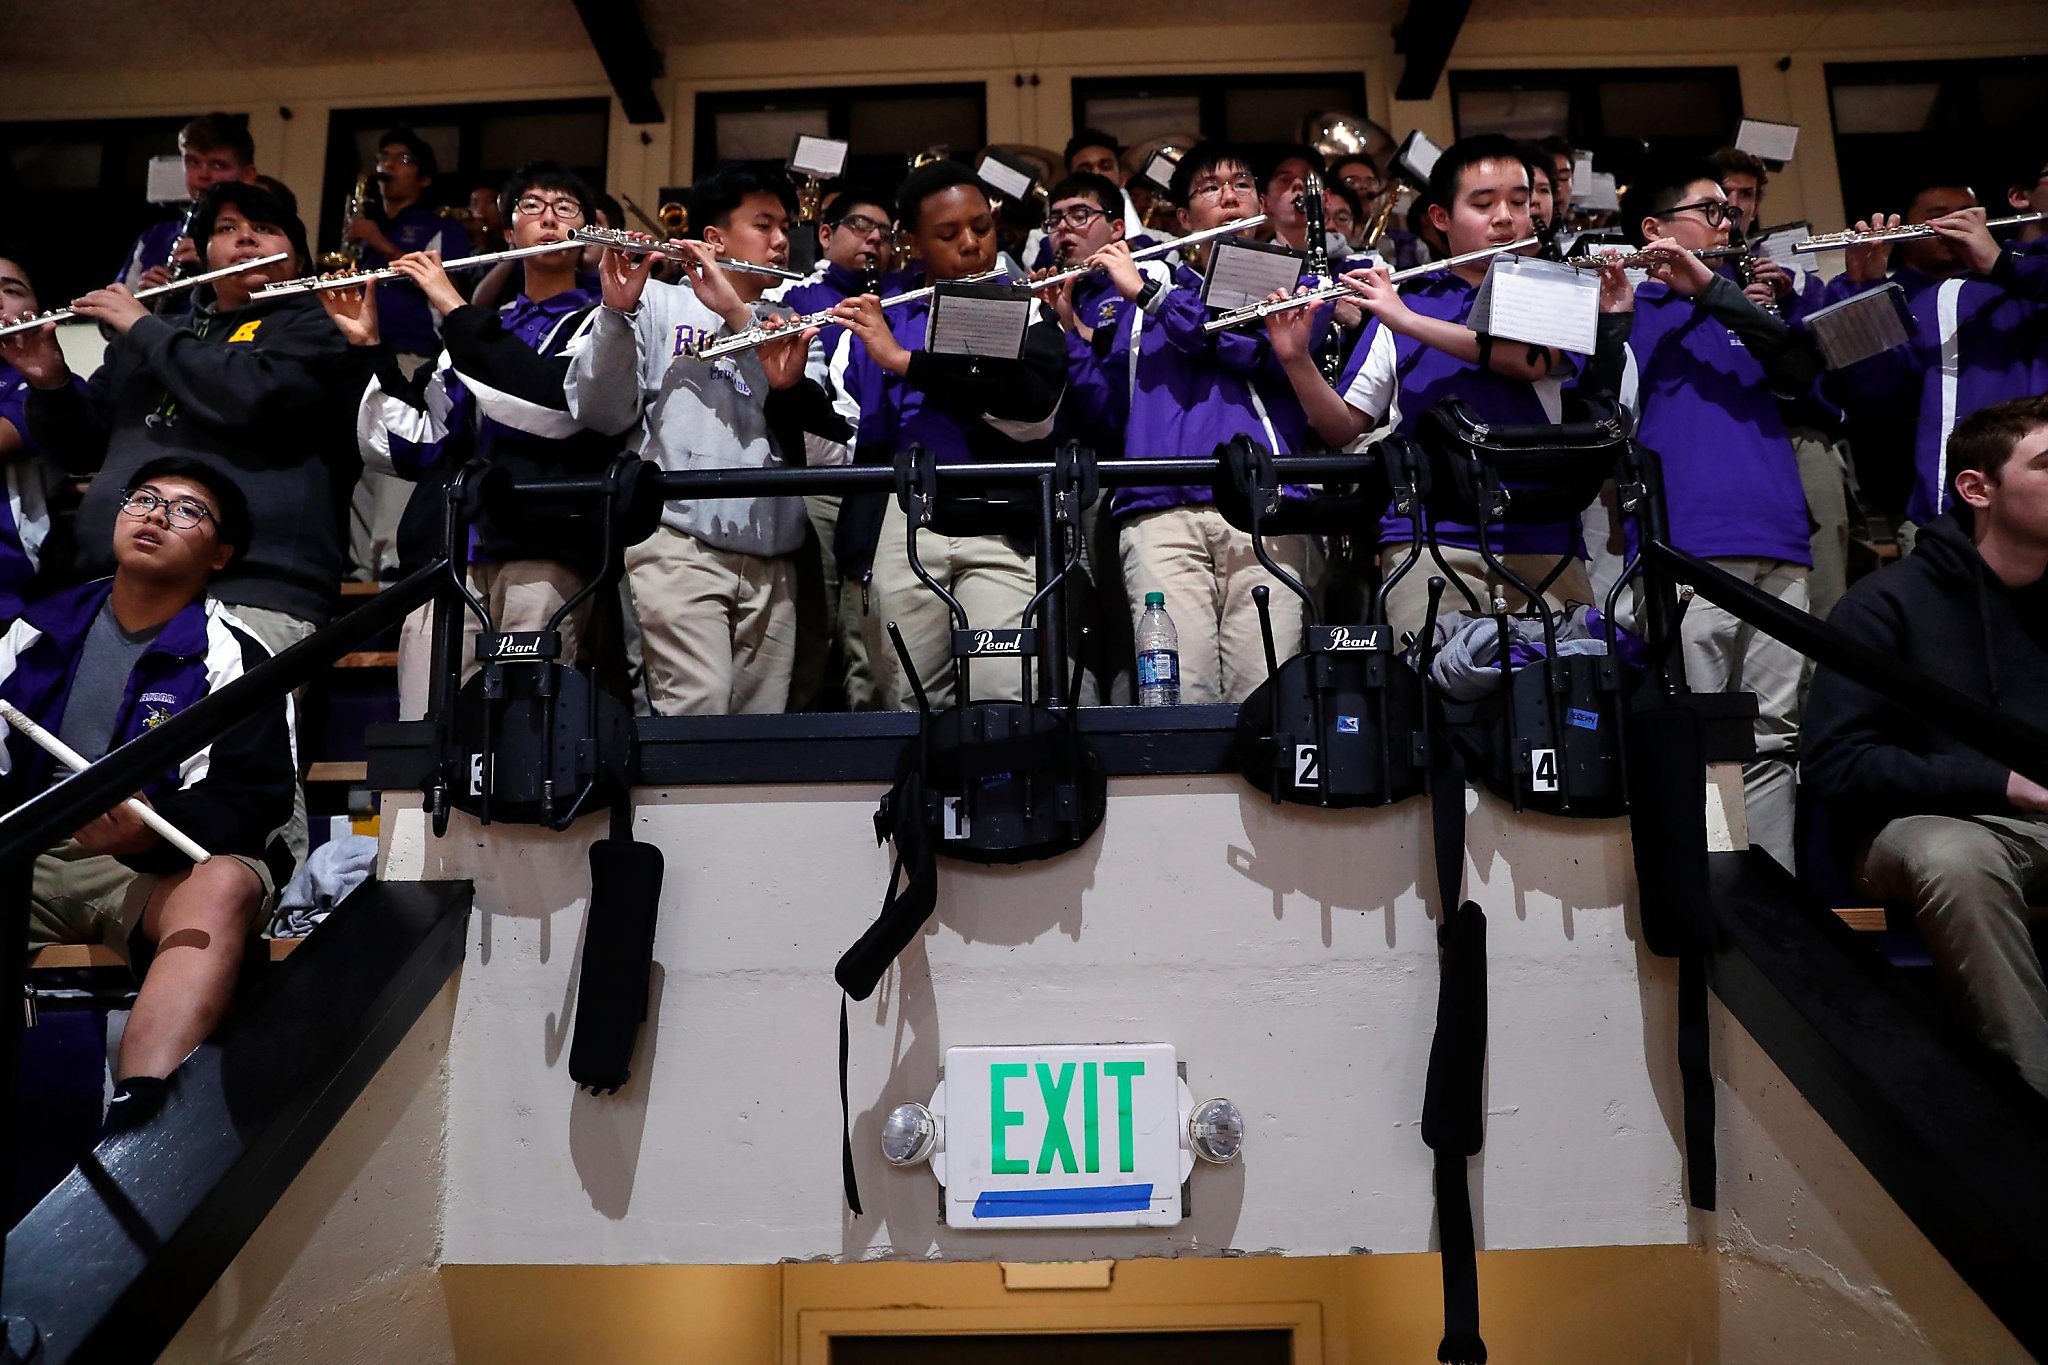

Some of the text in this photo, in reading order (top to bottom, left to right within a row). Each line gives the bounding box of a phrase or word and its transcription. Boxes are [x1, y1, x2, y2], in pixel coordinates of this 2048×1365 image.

[489, 634, 541, 657] Pearl
[968, 630, 1022, 654] Pearl
[1323, 626, 1378, 651] Pearl
[1299, 748, 1319, 785] 2
[1536, 752, 1557, 788] 4
[990, 1061, 1146, 1175] EXIT
